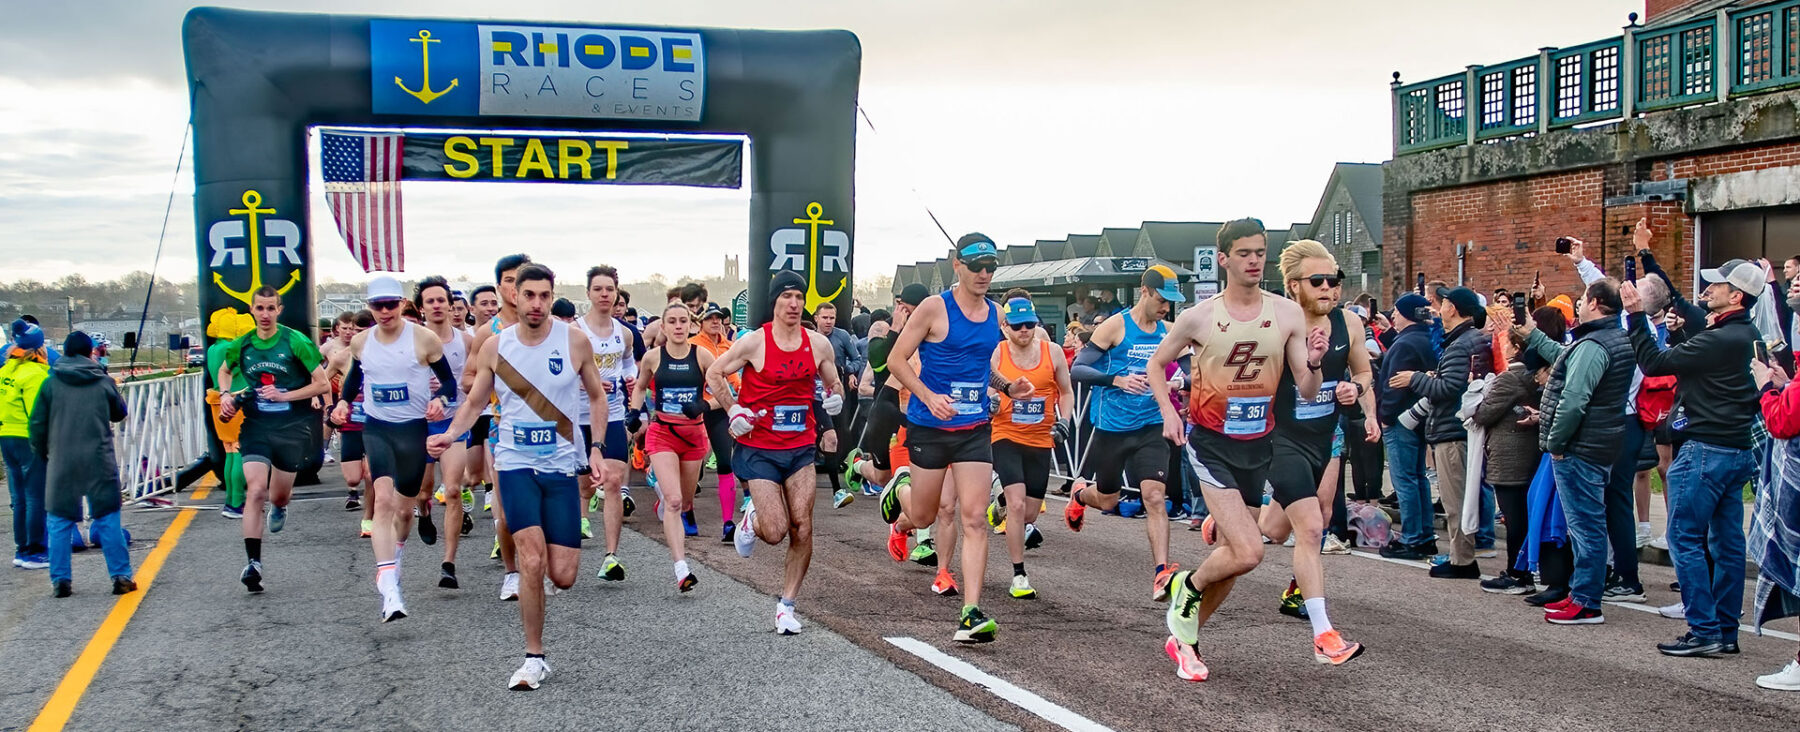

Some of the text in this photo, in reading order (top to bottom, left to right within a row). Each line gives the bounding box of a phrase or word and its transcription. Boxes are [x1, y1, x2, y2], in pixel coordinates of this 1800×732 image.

[491, 31, 695, 73] RHODE
[492, 73, 695, 101] RACES
[591, 104, 694, 117] & EVENTS
[443, 136, 629, 179] START
[1223, 341, 1269, 383] BC
[387, 389, 404, 401] 701
[677, 392, 693, 403] 252
[969, 389, 979, 402] 68
[1316, 389, 1333, 403] 560
[1027, 403, 1042, 413] 562
[1247, 405, 1265, 418] 351
[790, 412, 801, 423] 81
[530, 429, 551, 443] 873
